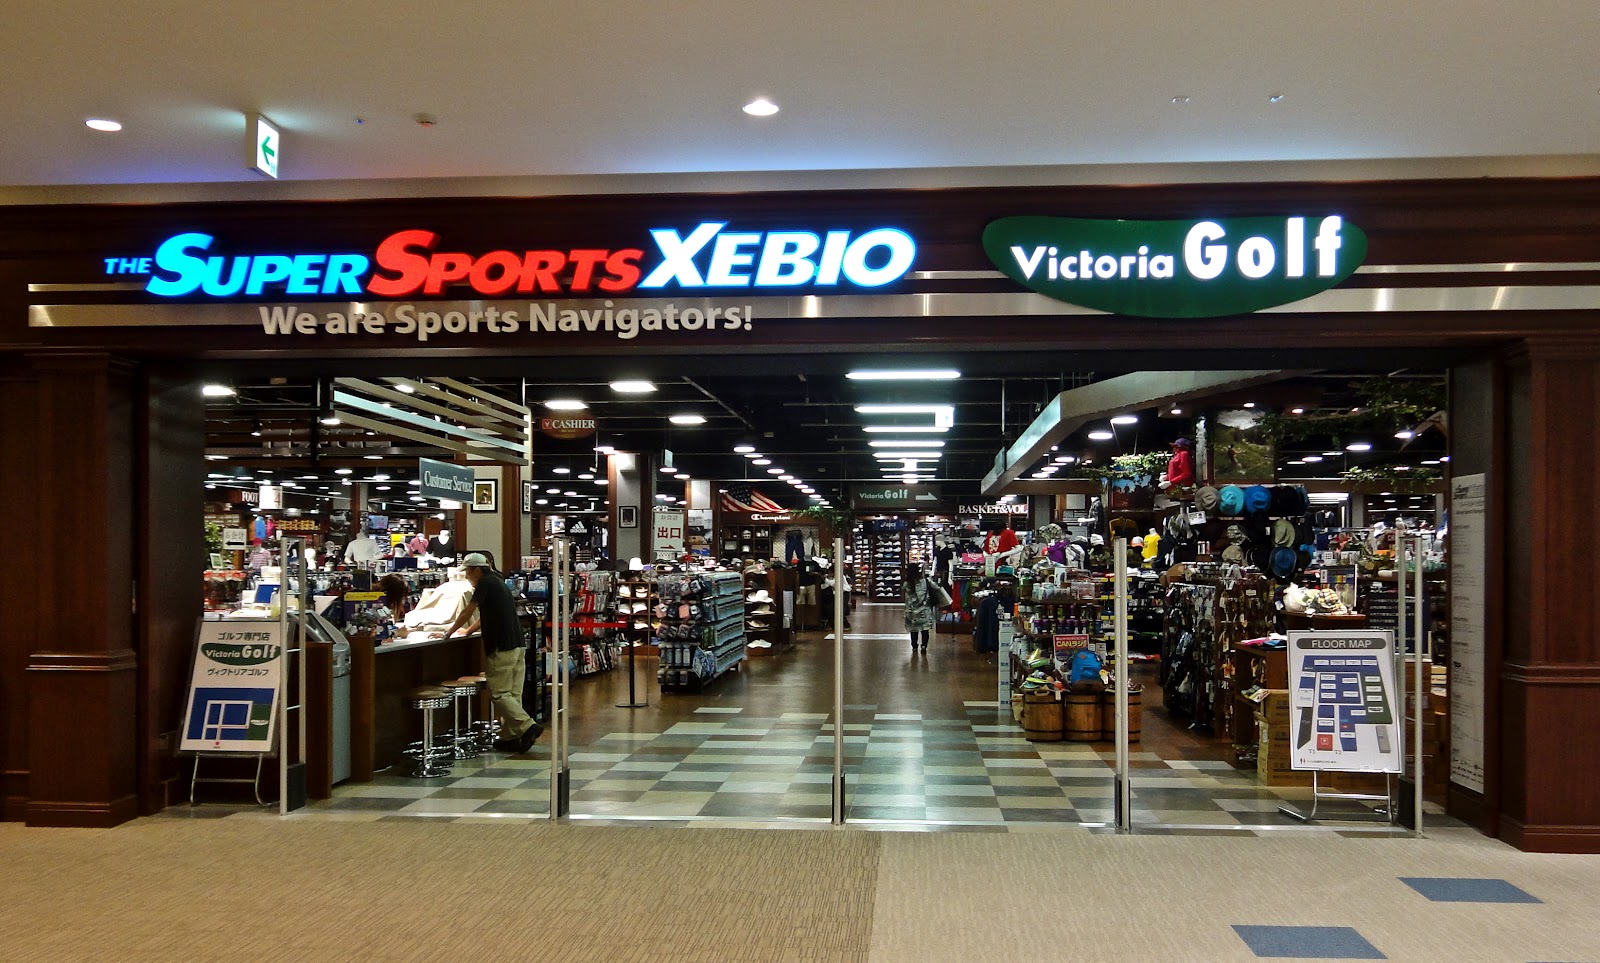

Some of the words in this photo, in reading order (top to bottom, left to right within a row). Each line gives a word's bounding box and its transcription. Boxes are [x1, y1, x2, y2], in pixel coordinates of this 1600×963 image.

[1010, 246, 1175, 280] Victoria
[1184, 215, 1342, 279] Golf
[104, 257, 151, 276] THE
[145, 232, 369, 297] SUPER
[367, 230, 644, 297] SPORTS
[640, 222, 916, 289] XEBIO
[260, 306, 317, 335] We
[323, 311, 386, 335] are
[394, 303, 520, 341] Sports
[529, 301, 755, 340] Navigators!
[552, 419, 595, 429] CASHIER
[424, 470, 453, 490] Customer
[452, 476, 472, 493] Service
[884, 489, 908, 499] Golf
[750, 514, 791, 522] Champion
[657, 526, 681, 538] 出口
[218, 632, 270, 641] ゴルフ専門店
[1312, 640, 1346, 648] FLOOR
[1349, 640, 1372, 648] MAP
[206, 650, 240, 658] Victoria
[242, 646, 276, 658] Golf
